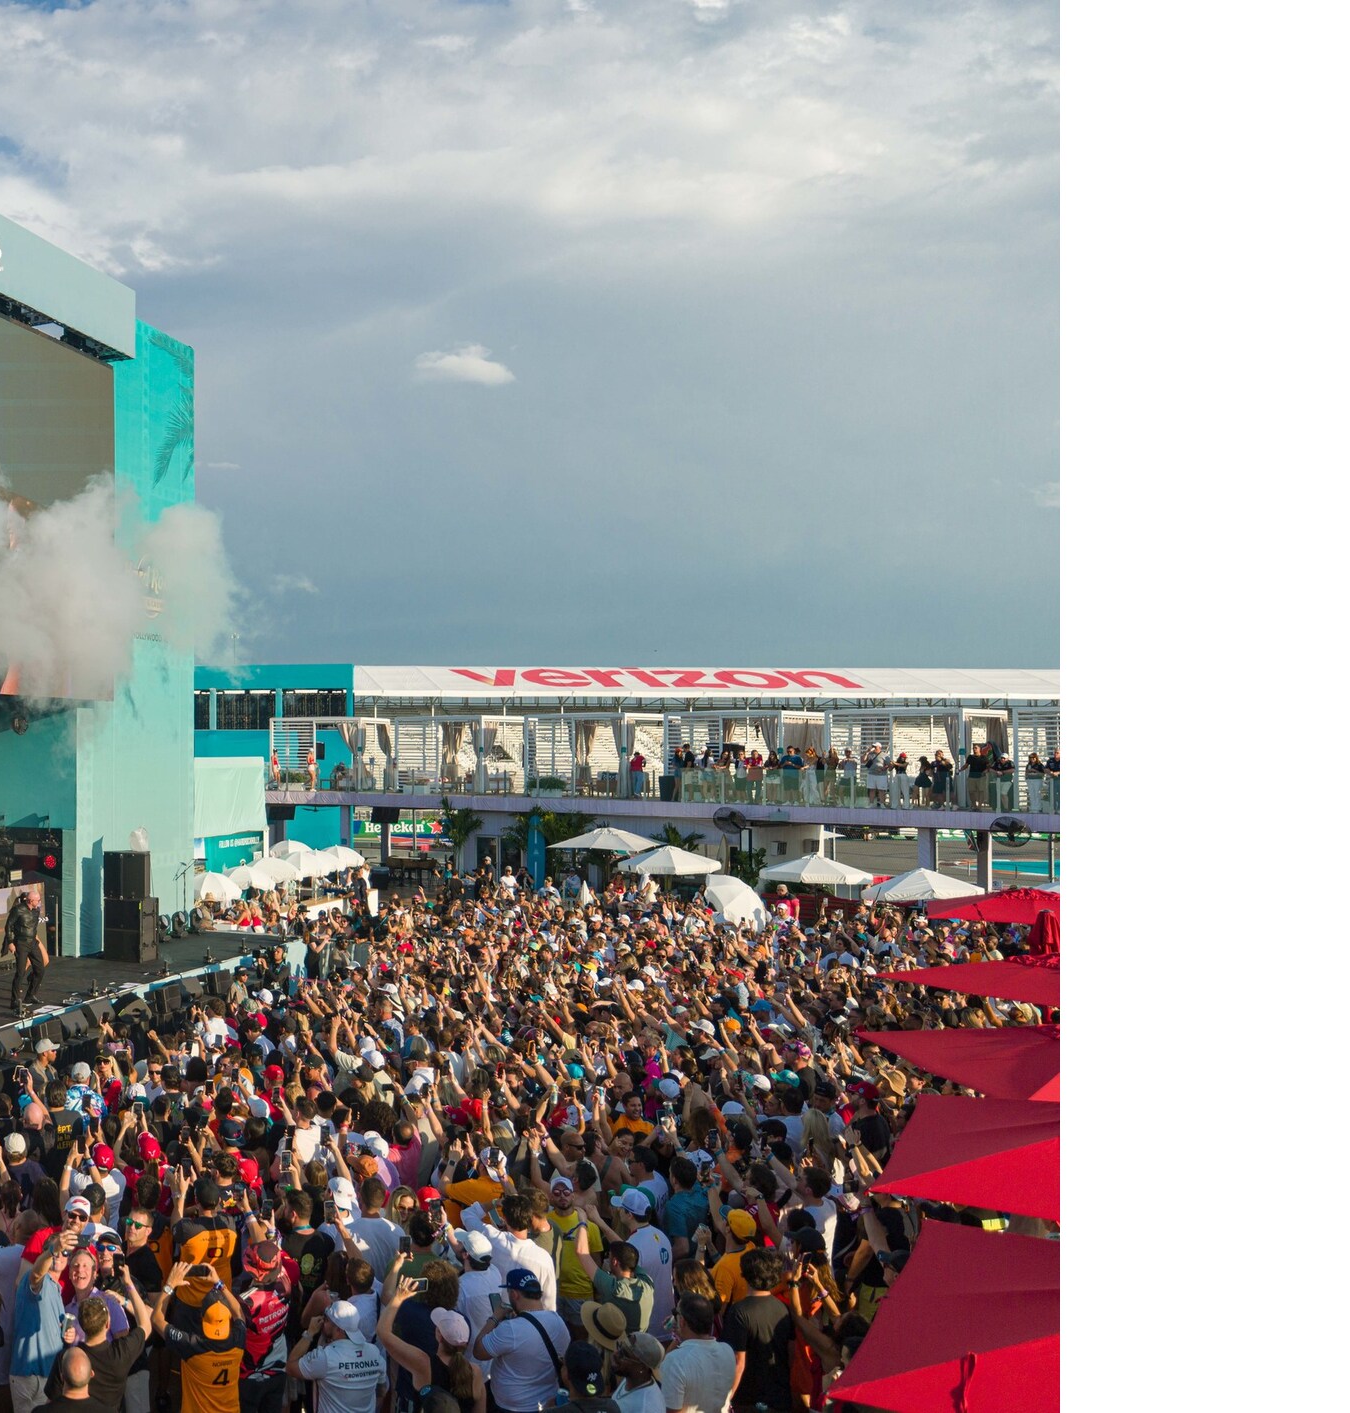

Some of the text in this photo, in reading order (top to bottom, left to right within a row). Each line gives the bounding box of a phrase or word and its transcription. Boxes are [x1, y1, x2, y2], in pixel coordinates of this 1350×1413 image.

[450, 667, 864, 689] verizon
[364, 821, 425, 834] Heneken
[338, 1360, 380, 1370] PETRONAS
[212, 1368, 230, 1386] 4
